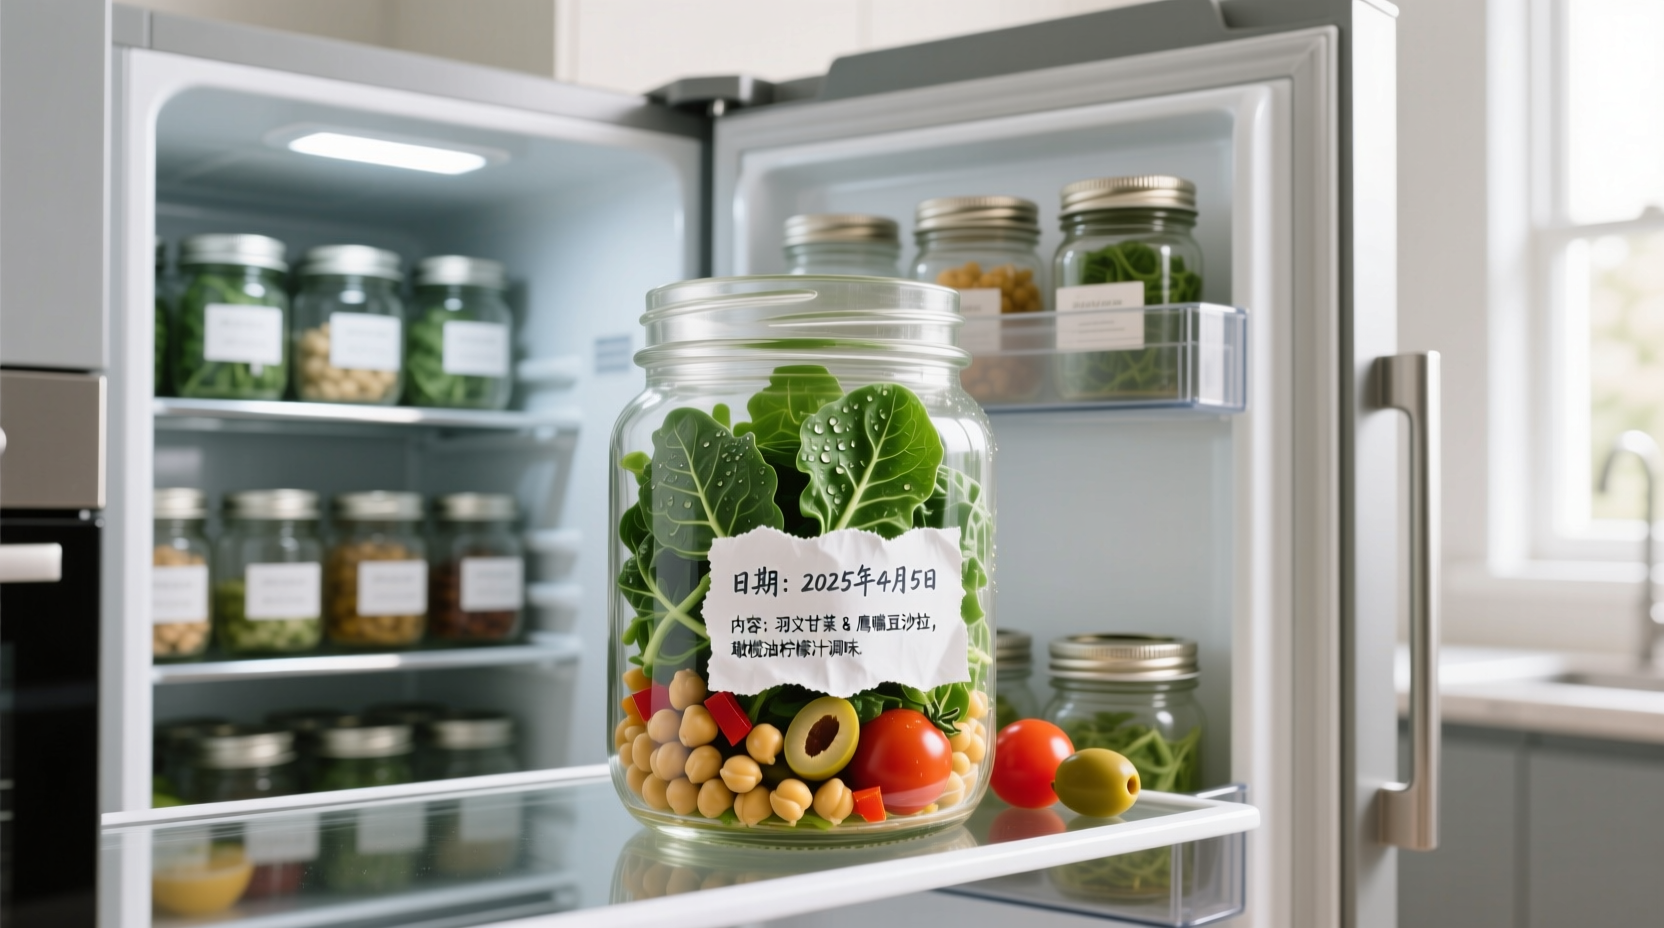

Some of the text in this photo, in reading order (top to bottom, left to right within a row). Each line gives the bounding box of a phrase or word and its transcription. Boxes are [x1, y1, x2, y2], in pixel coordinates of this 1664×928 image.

[733, 564, 936, 597] 日期：2025年4月5日
[842, 616, 851, 632] &
